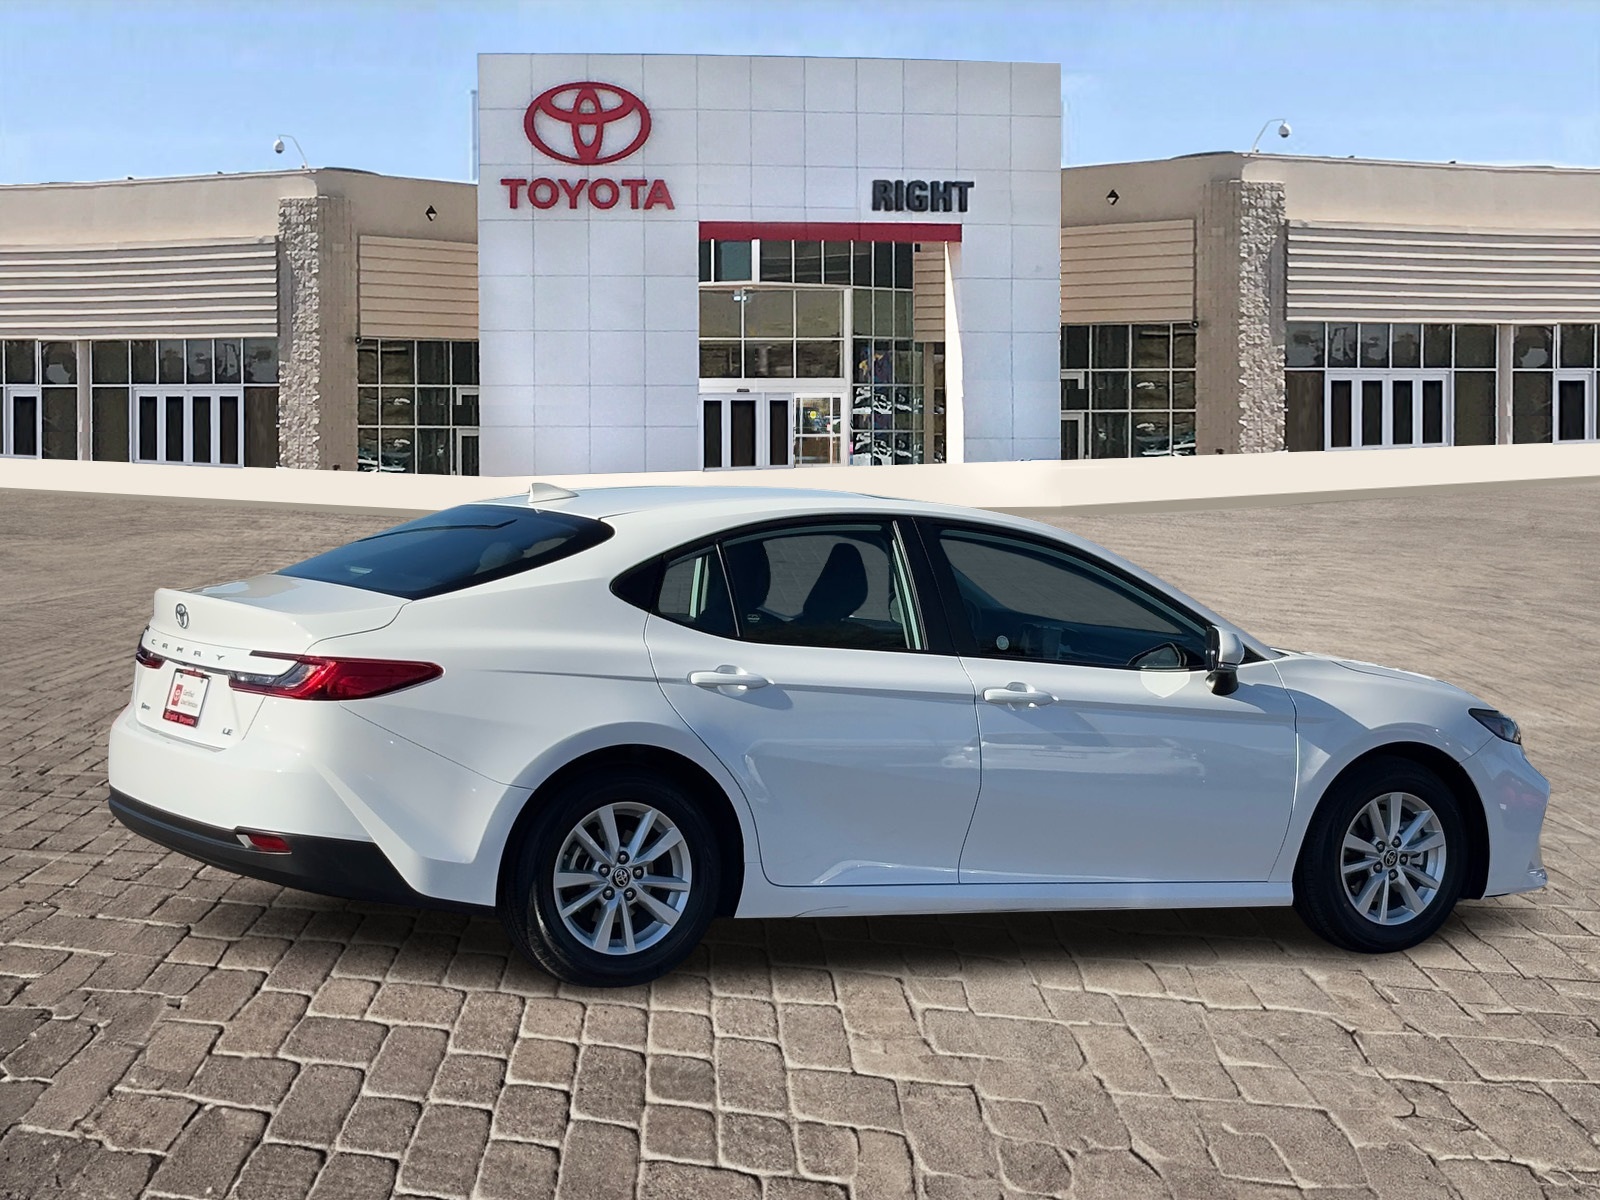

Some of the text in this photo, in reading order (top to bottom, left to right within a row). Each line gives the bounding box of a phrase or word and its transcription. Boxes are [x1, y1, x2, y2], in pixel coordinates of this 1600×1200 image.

[500, 177, 675, 210] TOYOTA
[871, 179, 975, 213] RIGHT
[151, 639, 225, 660] CAMRY
[222, 727, 233, 736] LE
